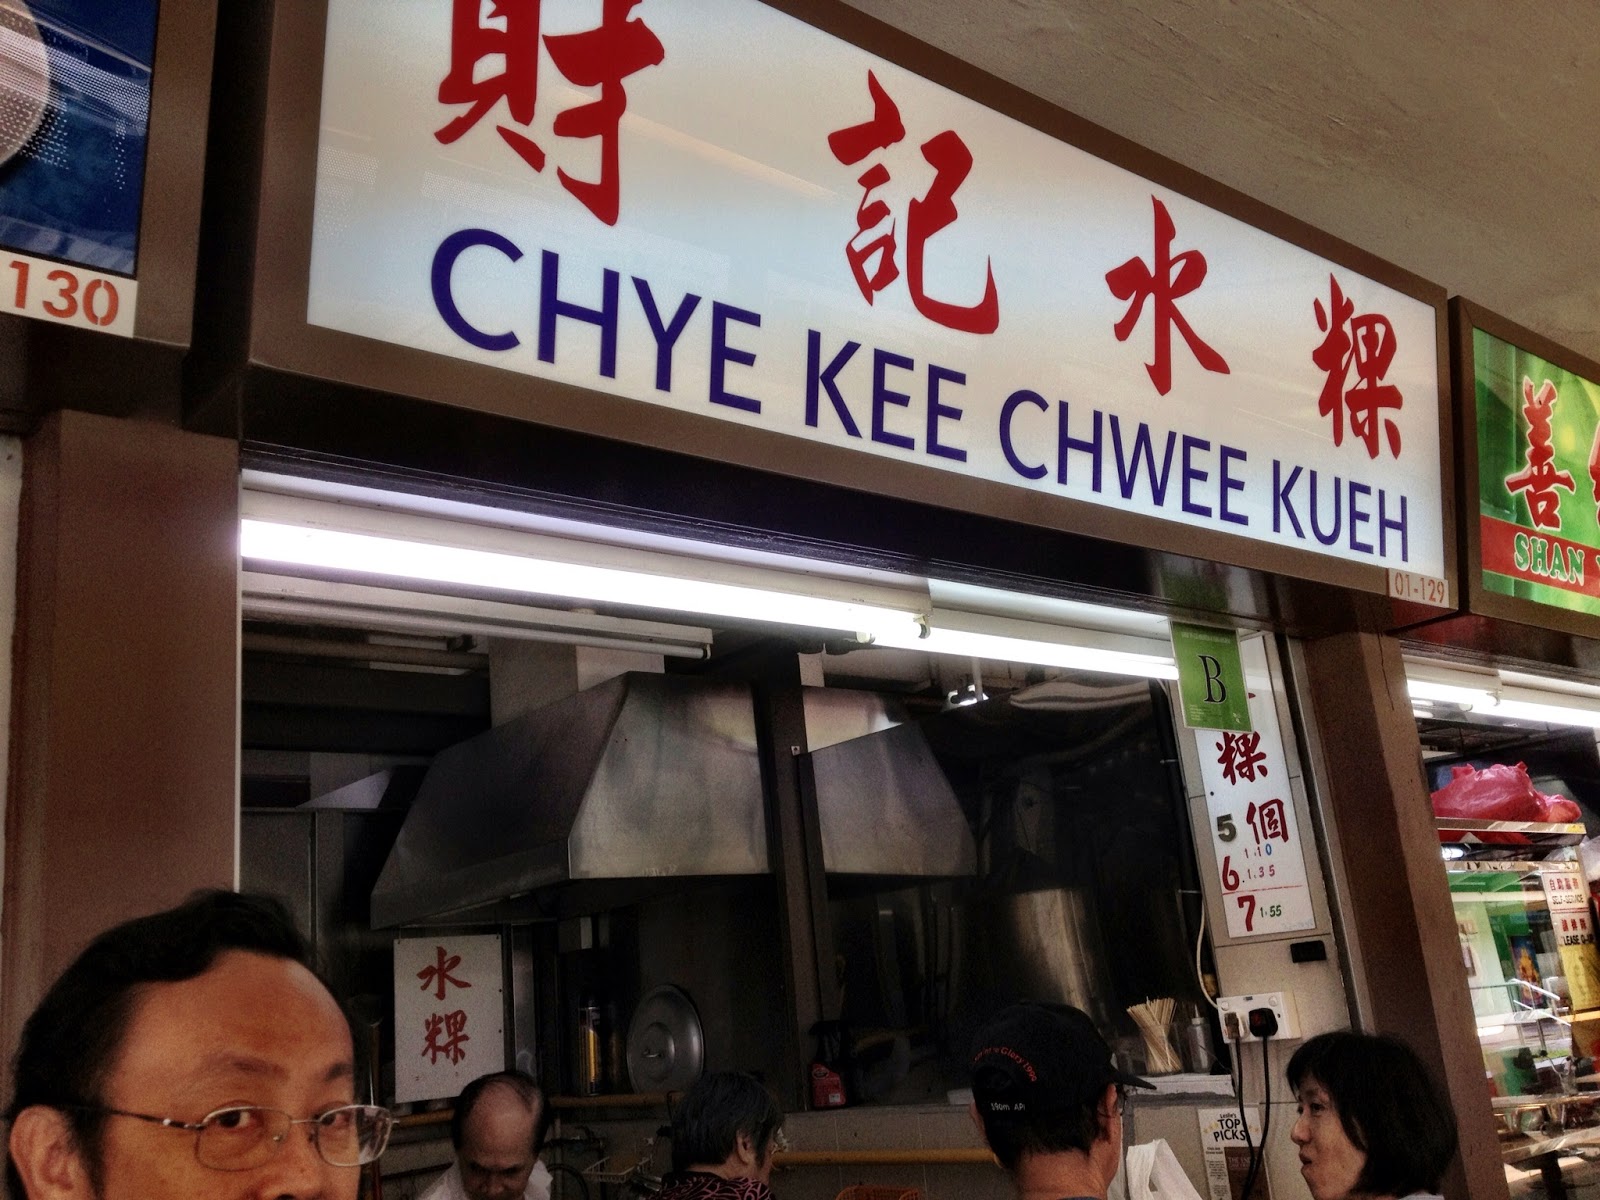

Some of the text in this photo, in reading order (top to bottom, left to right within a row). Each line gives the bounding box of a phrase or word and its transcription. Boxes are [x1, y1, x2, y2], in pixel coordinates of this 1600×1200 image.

[9, 260, 119, 326] 130
[430, 227, 1408, 562] CHYE KEE CHWEE KUEH
[1504, 375, 1600, 532] 善
[1513, 532, 1585, 587] SHAN
[1394, 571, 1445, 604] 01-129
[1197, 654, 1227, 704] B
[1237, 894, 1256, 932] 7
[1259, 904, 1282, 918] 1.55
[1561, 935, 1580, 946] LEASE
[1213, 1129, 1246, 1142] PICKS
[1217, 1118, 1241, 1130] TOP
